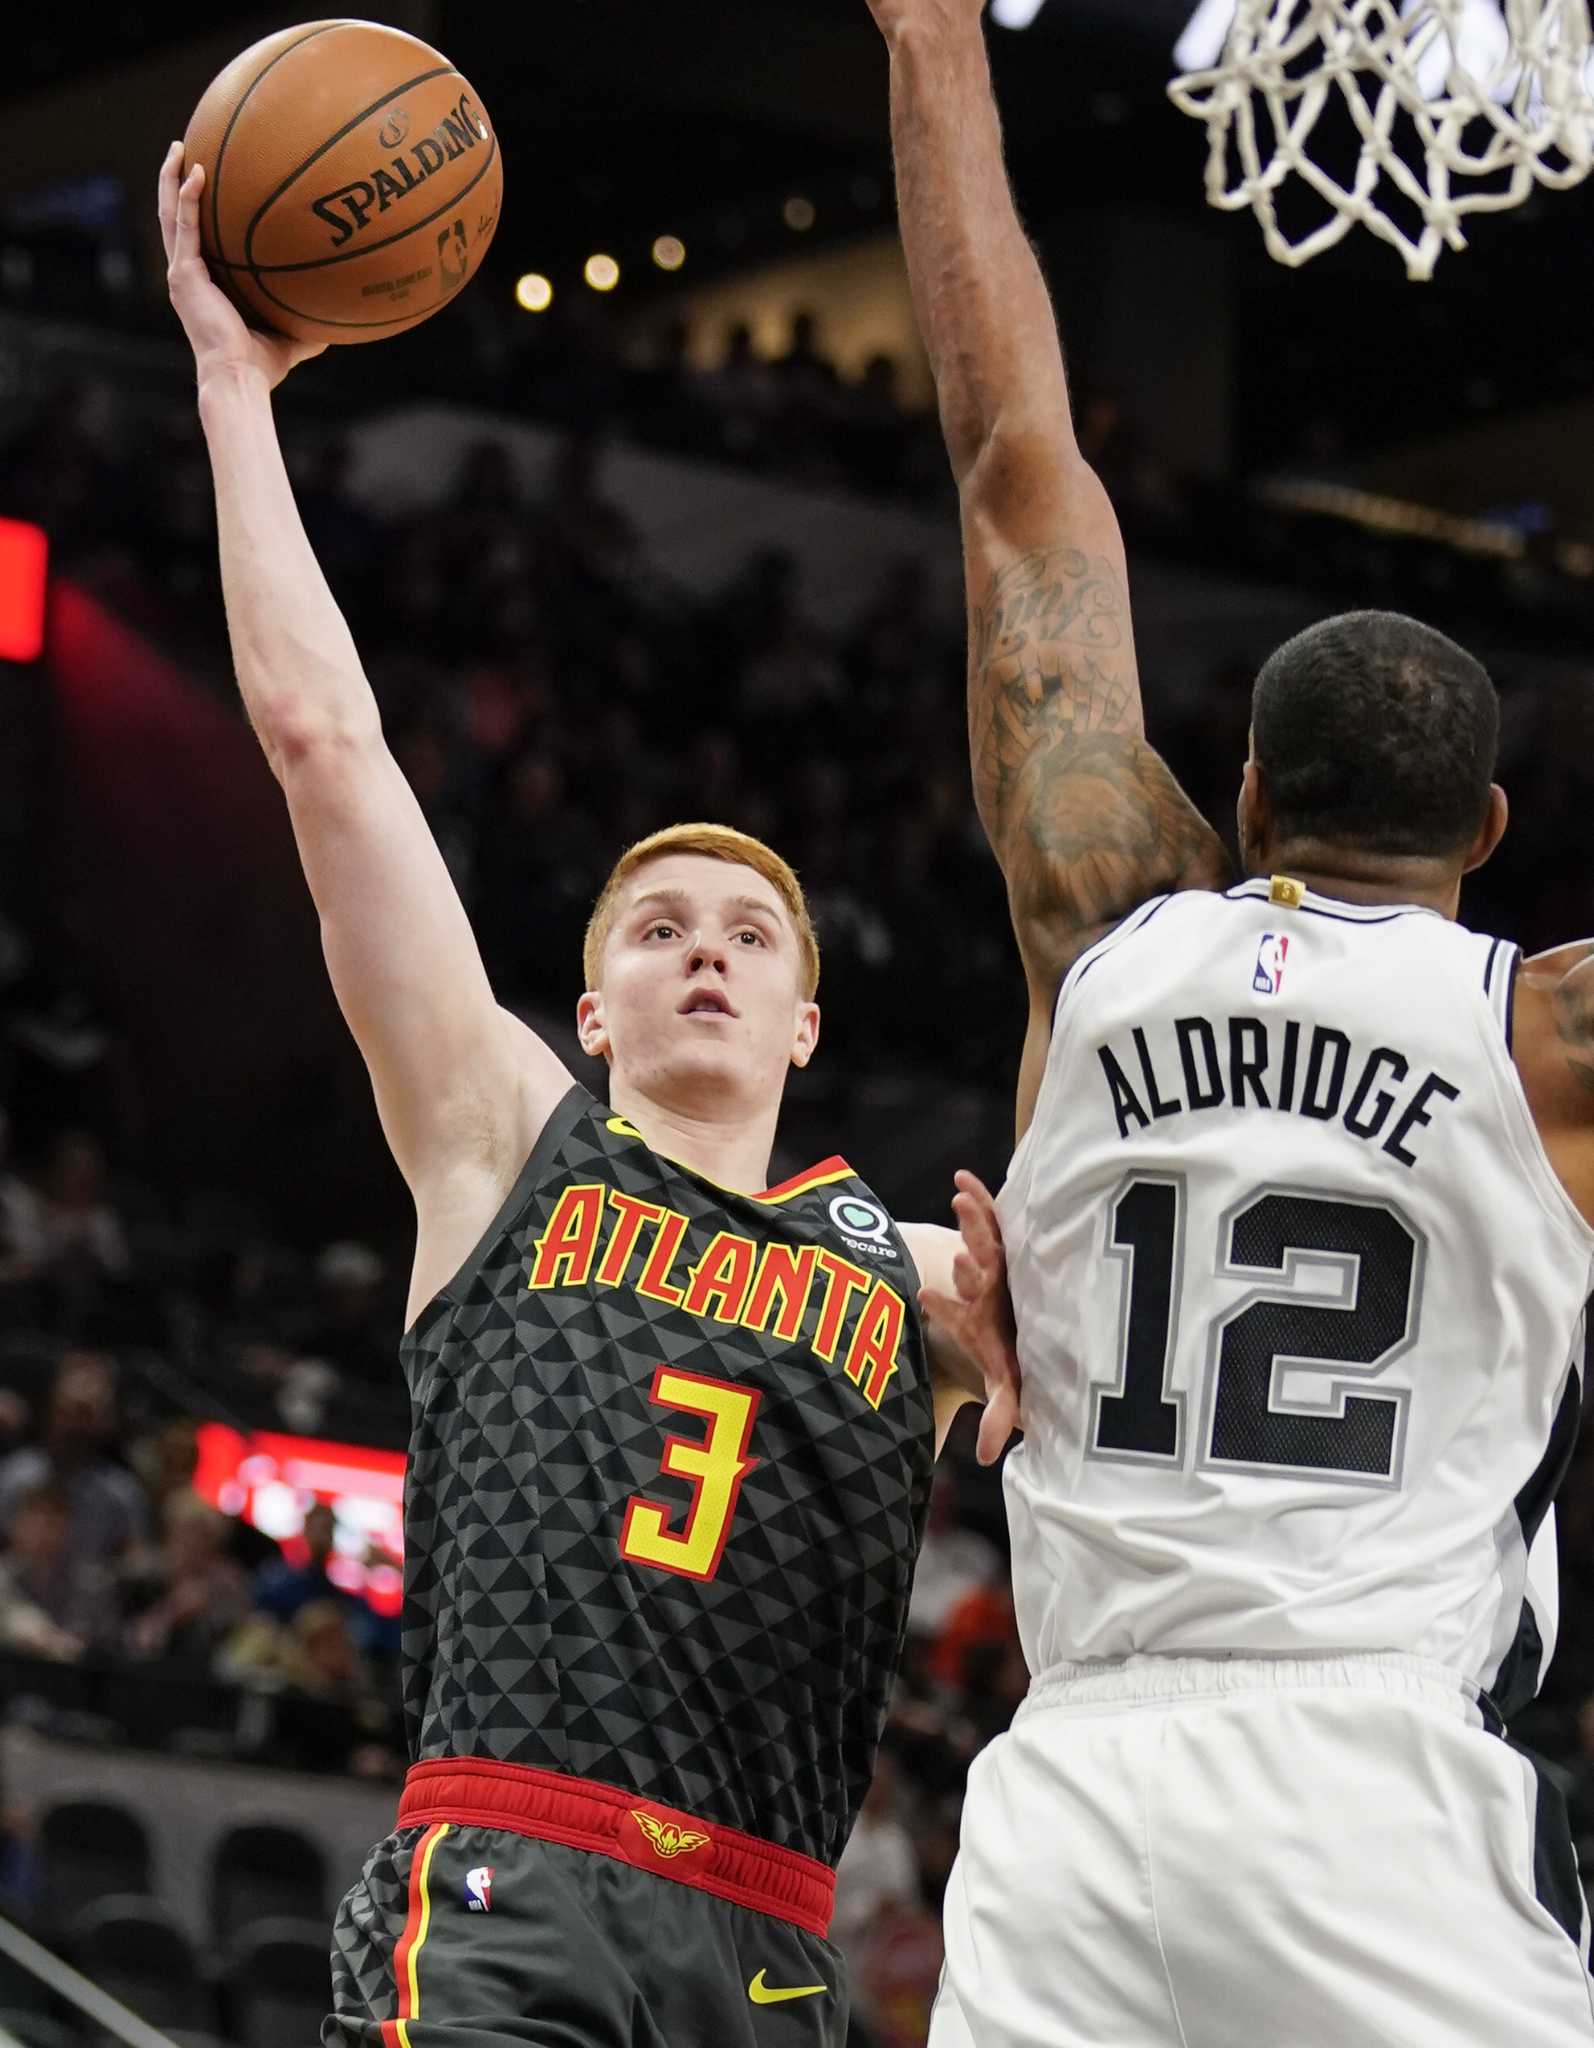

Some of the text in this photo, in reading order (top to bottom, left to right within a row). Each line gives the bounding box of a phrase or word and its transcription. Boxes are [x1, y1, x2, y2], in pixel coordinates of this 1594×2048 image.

[1098, 1017, 1460, 1167] ALDRIDGE
[528, 1184, 905, 1411] ATLANTA
[1085, 1168, 1427, 1491] 12
[620, 1365, 762, 1582] 3
